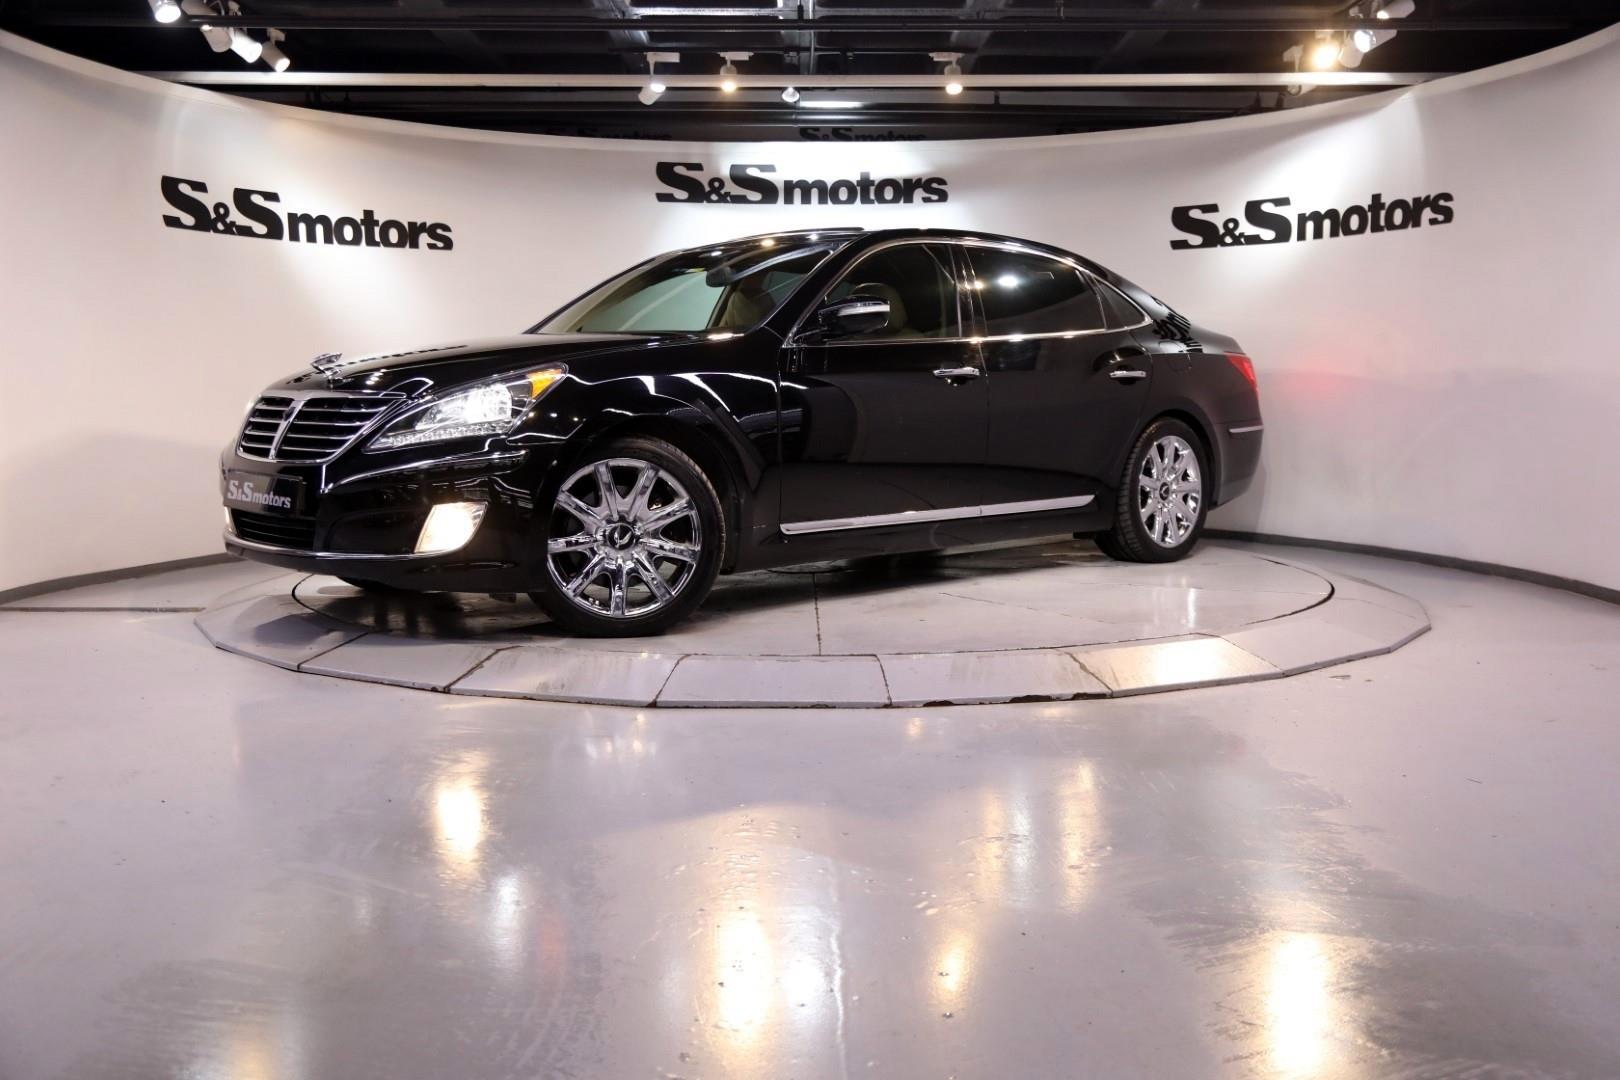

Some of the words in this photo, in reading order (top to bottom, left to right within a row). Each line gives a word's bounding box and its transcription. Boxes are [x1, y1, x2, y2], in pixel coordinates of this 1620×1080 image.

[655, 161, 779, 204] S&S
[783, 171, 949, 205] motors
[161, 175, 284, 240] S&S
[287, 209, 453, 251] motors
[1170, 196, 1292, 250] S&S
[1297, 192, 1454, 241] motors
[252, 491, 291, 508] motors
